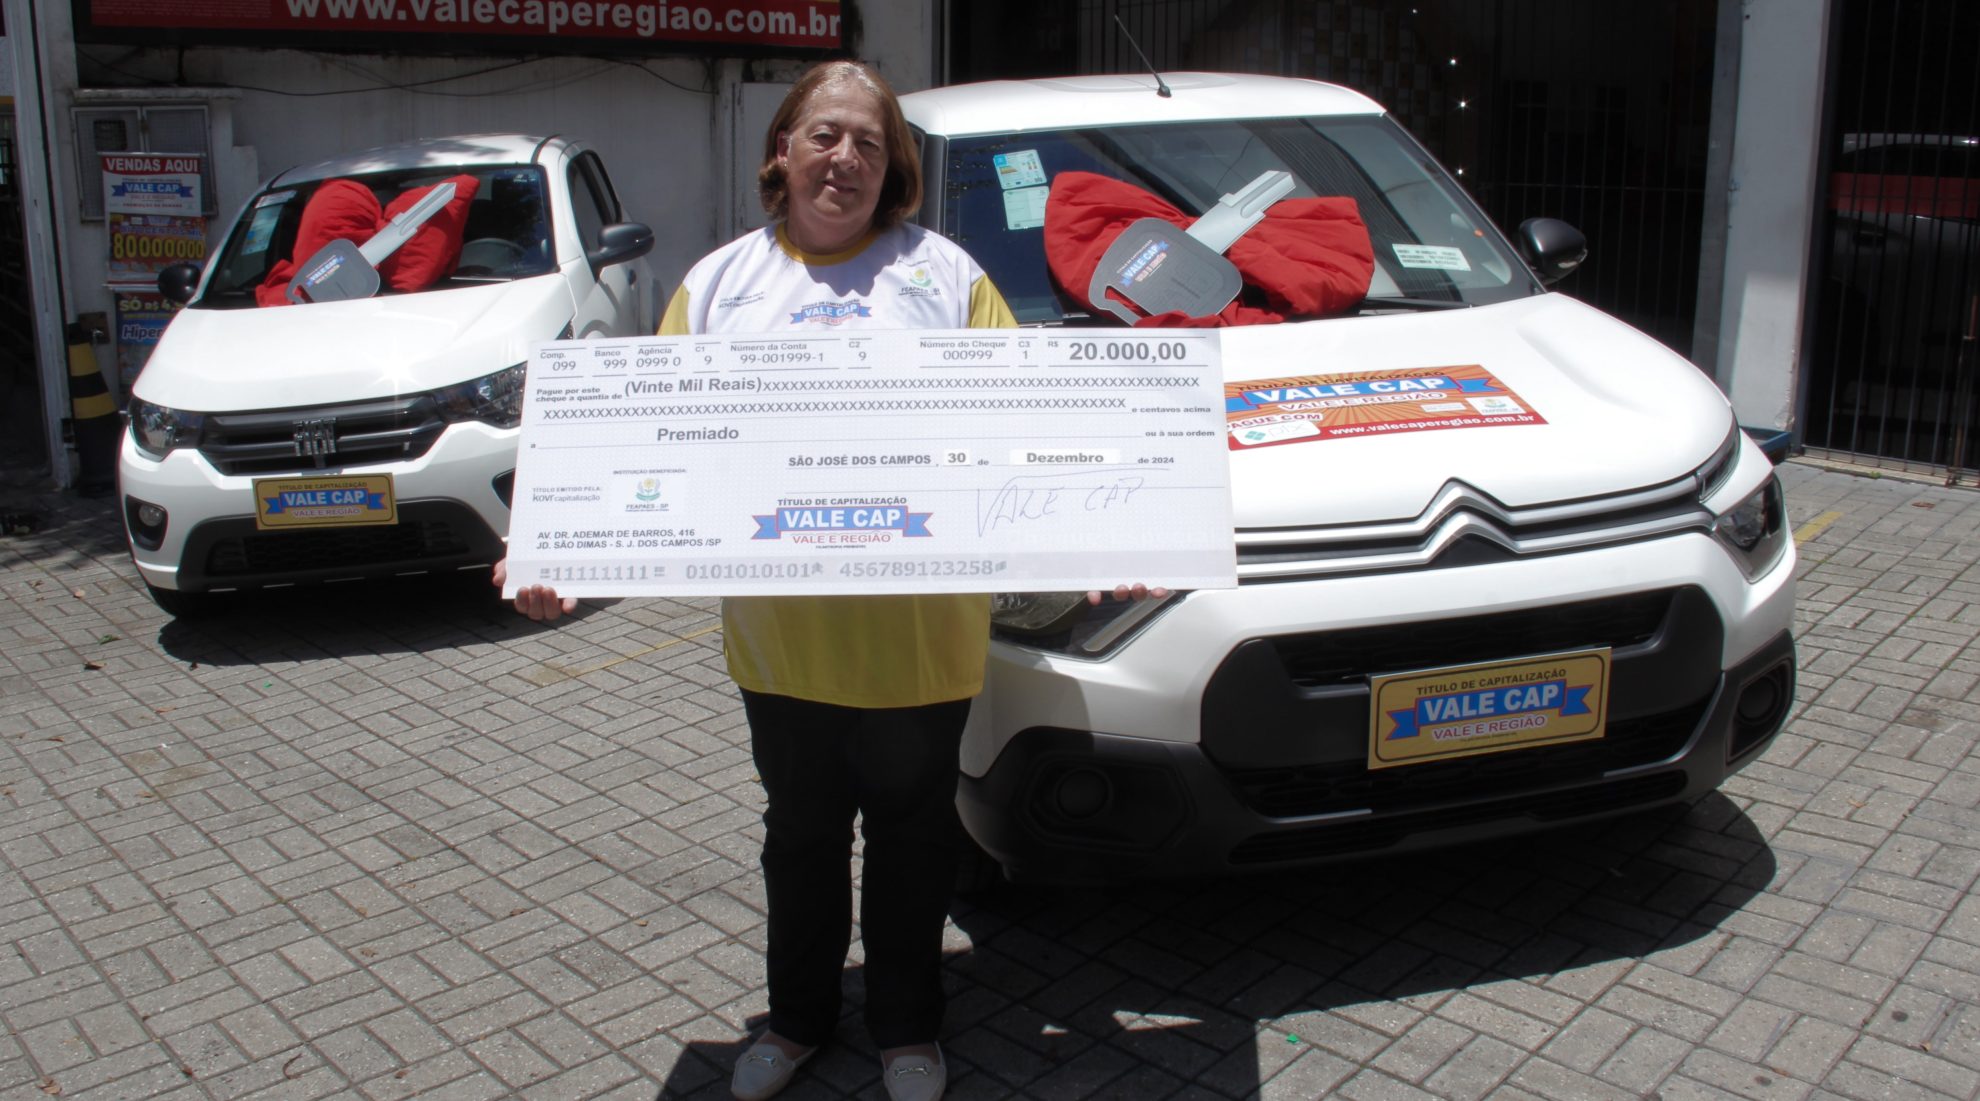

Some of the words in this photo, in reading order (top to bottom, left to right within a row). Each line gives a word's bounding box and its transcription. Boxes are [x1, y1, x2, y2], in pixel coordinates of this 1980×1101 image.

[286, 0, 841, 36] www.valecaperegiao.com.br
[106, 158, 160, 171] VENDAS
[165, 159, 198, 172] AQUI
[126, 183, 153, 192] VALE
[157, 183, 180, 193] CAP
[804, 306, 833, 317] VALE
[836, 304, 858, 316] CAP
[731, 343, 765, 352] Número
[767, 343, 779, 351] da
[780, 342, 807, 350] Conta
[920, 340, 955, 348] Número
[958, 340, 970, 348] do
[972, 340, 1007, 349] Cheque
[540, 352, 566, 360] Comp.
[638, 347, 672, 356] Agência
[858, 351, 867, 361] 9
[943, 350, 993, 360] 000999
[1022, 350, 1029, 360] 1
[1069, 342, 1187, 363] 20.000,00
[603, 358, 628, 369] 999
[636, 356, 668, 368] 0999
[672, 356, 681, 366] 0
[704, 355, 713, 365] 9
[740, 352, 824, 364] 99-001999-1
[552, 361, 577, 371] 099
[536, 388, 563, 396] Pague
[625, 380, 673, 397] (Vinte
[679, 378, 703, 392] Mil
[1234, 381, 1294, 391] TÍTULO
[1253, 384, 1360, 402] VALE
[1369, 378, 1445, 393] CAP
[577, 394, 609, 402] quantia
[1282, 401, 1334, 410] VALE
[1227, 417, 1277, 430] AGUE
[1329, 415, 1535, 434] www.valecaperegiao.com.br
[657, 427, 739, 442] Premiado
[788, 455, 813, 466] SÃO
[817, 454, 849, 466] JOSÉ
[852, 456, 877, 465] DOS
[880, 455, 932, 465] CAMPOS
[947, 452, 966, 464] 30
[1026, 452, 1104, 463] Dezembro
[284, 492, 327, 506] VALE
[331, 490, 364, 504] CAP
[1084, 477, 1144, 511] CAP
[778, 498, 812, 506] TÍTULO
[831, 496, 907, 505] CAPITALIZAÇÃO
[784, 510, 845, 528] VALE
[852, 509, 901, 527] CAP
[538, 531, 552, 539] AV.
[554, 531, 570, 539] DR.
[572, 530, 614, 538] ADEMAR
[617, 530, 630, 538] DE
[632, 529, 676, 538] BARROS,
[678, 529, 695, 537] 416
[793, 535, 825, 544] VALE
[829, 534, 836, 543] E
[840, 532, 891, 543] REGIÃO
[536, 541, 551, 550] JD.
[554, 539, 575, 549] SÃO
[577, 540, 607, 549] DIMAS
[615, 540, 624, 548] S.
[627, 540, 635, 548] J.
[637, 539, 658, 547] DOS
[661, 539, 703, 547] CAMPOS
[705, 538, 722, 547] /SP
[1417, 681, 1457, 695] TÍTULO
[1461, 679, 1475, 689] DE
[1479, 669, 1567, 687] CAPITALIZAÇÃO
[1424, 692, 1495, 721] VALE
[1504, 684, 1559, 711] CAP
[1433, 725, 1471, 740] VALE
[1475, 723, 1484, 733] E
[1489, 715, 1545, 732] REGIÃO
